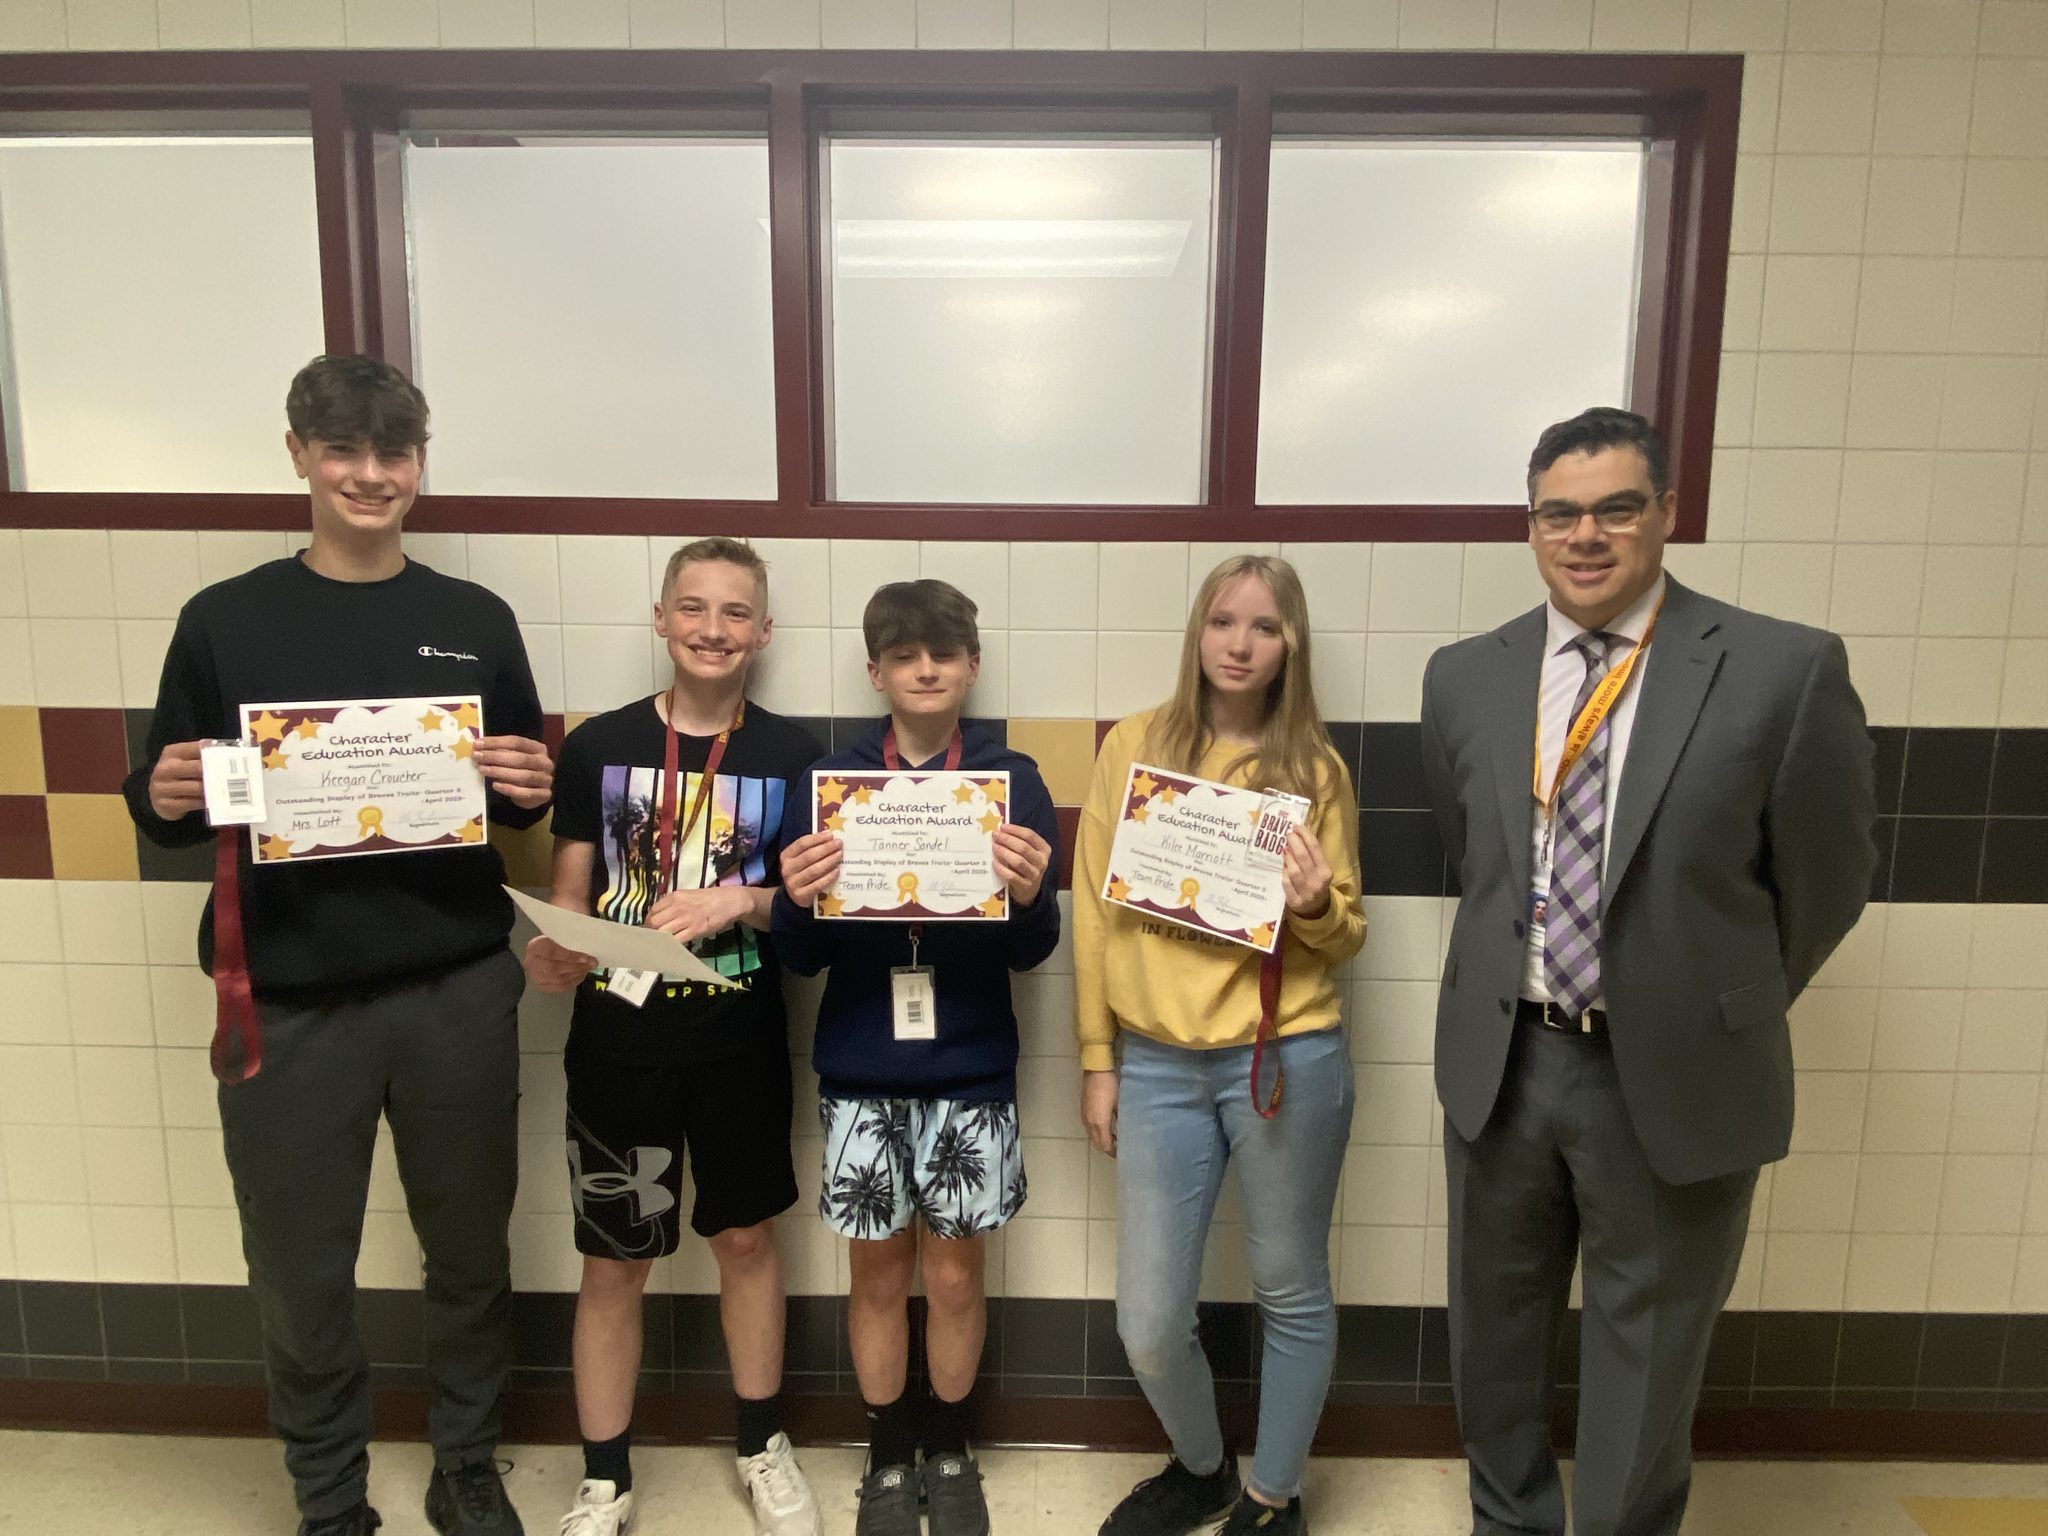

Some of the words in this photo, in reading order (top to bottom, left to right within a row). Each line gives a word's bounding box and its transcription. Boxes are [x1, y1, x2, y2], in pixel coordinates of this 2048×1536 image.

[418, 646, 479, 661] Champion
[1577, 707, 1601, 741] always
[1598, 680, 1618, 705] more
[329, 732, 412, 745] Character
[302, 748, 384, 761] Education
[389, 744, 444, 757] Award
[322, 770, 365, 792] Keegan
[878, 802, 946, 813] Character
[856, 814, 923, 825] Education
[926, 816, 972, 826] Award
[1179, 806, 1240, 830] Character
[1157, 813, 1215, 836] Education
[1218, 832, 1252, 847] Awar
[868, 837, 909, 851] Tanner
[1254, 829, 1286, 856] BADG
[838, 880, 863, 891] Team
[1142, 922, 1160, 935] IN
